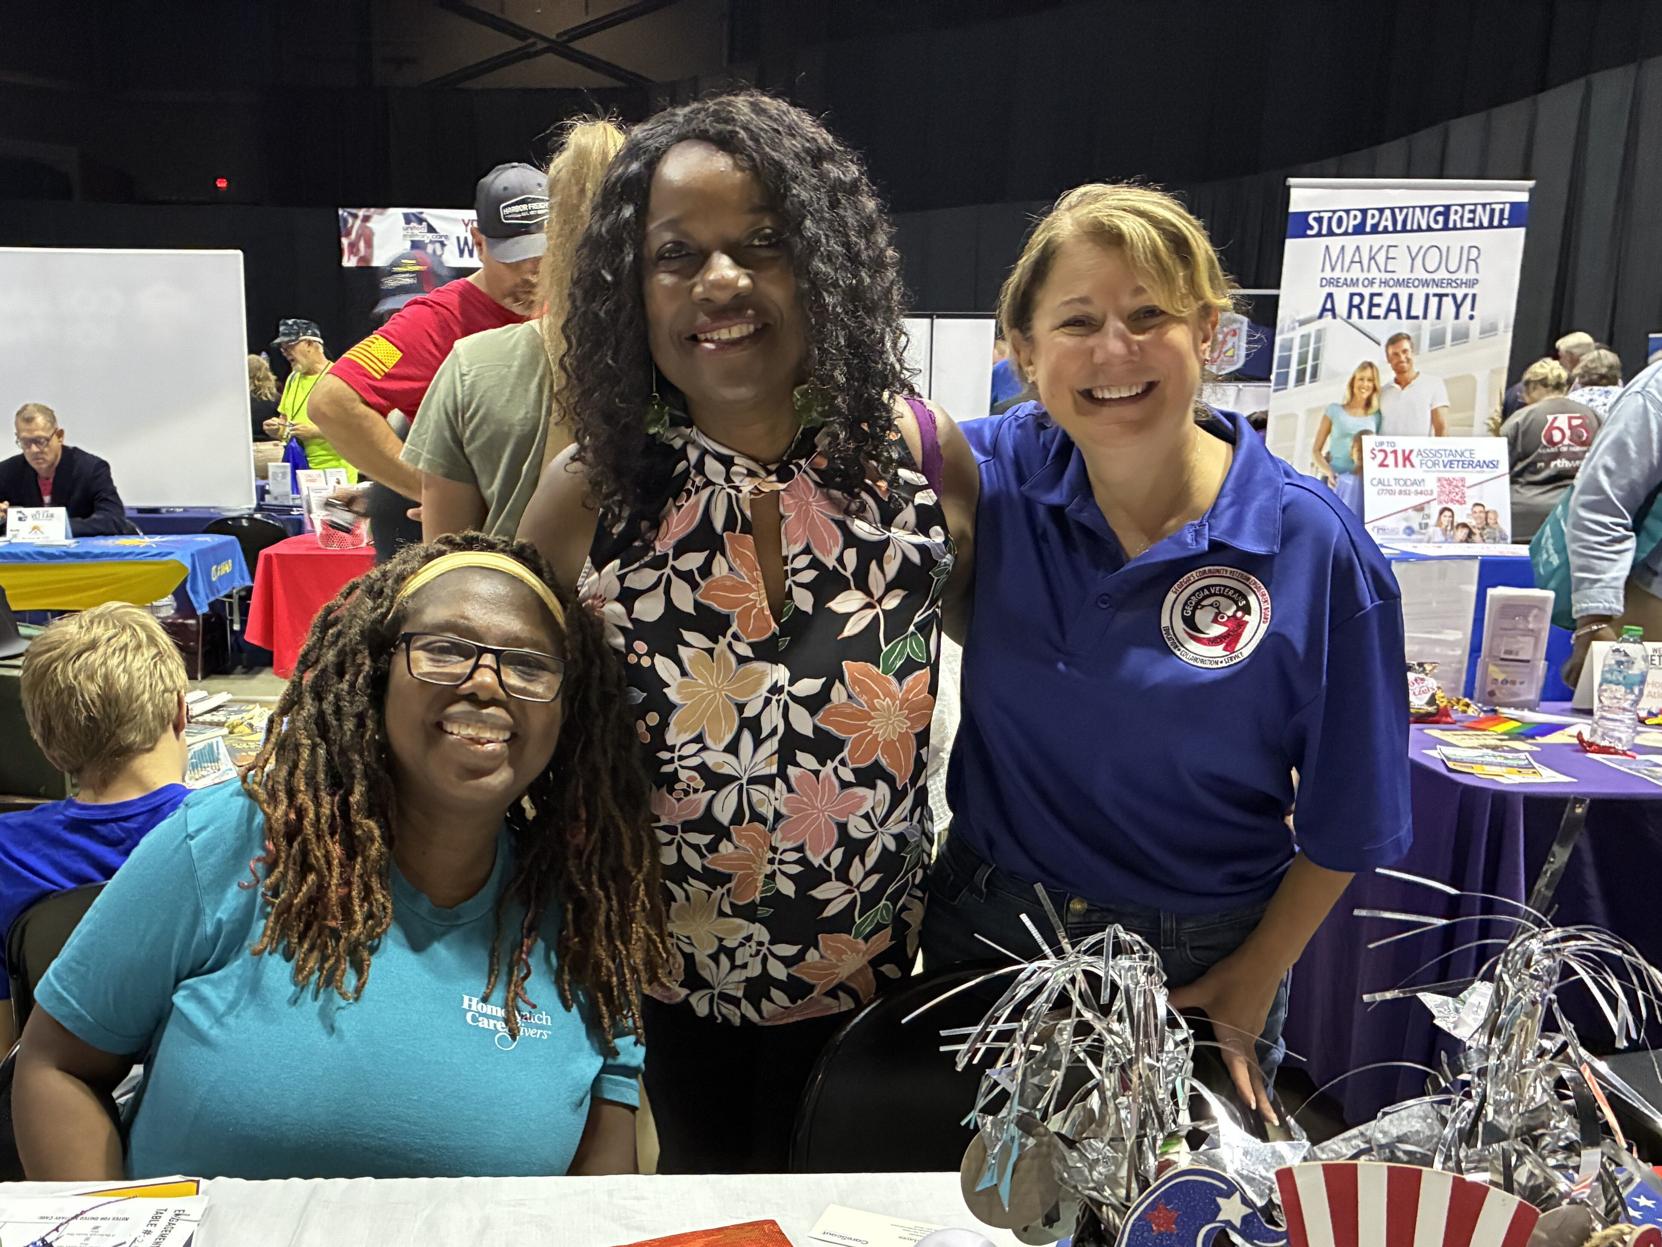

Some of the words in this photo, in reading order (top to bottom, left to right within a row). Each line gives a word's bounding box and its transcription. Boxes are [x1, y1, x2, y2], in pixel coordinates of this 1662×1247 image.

[1305, 211, 1362, 235] STOP
[1365, 205, 1445, 232] PAYING
[1447, 203, 1511, 228] RENT!
[1320, 244, 1398, 273] MAKE
[1406, 244, 1482, 274] YOUR
[1319, 277, 1360, 288] DREAM
[1361, 278, 1377, 288] OF
[1378, 278, 1480, 289] HOMEOWNERSHIP
[1316, 292, 1337, 320] A
[1345, 292, 1478, 320] REALITY!
[1542, 415, 1591, 447] 65
[1370, 447, 1415, 468] $21K
[1416, 449, 1476, 459] ASSISTANCE
[1419, 459, 1440, 469] FOR
[1441, 459, 1500, 469] VETERANS!
[1370, 477, 1393, 487] CALL
[1394, 478, 1425, 487] TODAY!
[1184, 589, 1210, 616] GEORGIA
[1210, 586, 1246, 606] VETERANS
[1162, 626, 1179, 650] EDUCATION
[1224, 652, 1244, 664] SERVICE
[822, 1231, 869, 1245] CareScout
